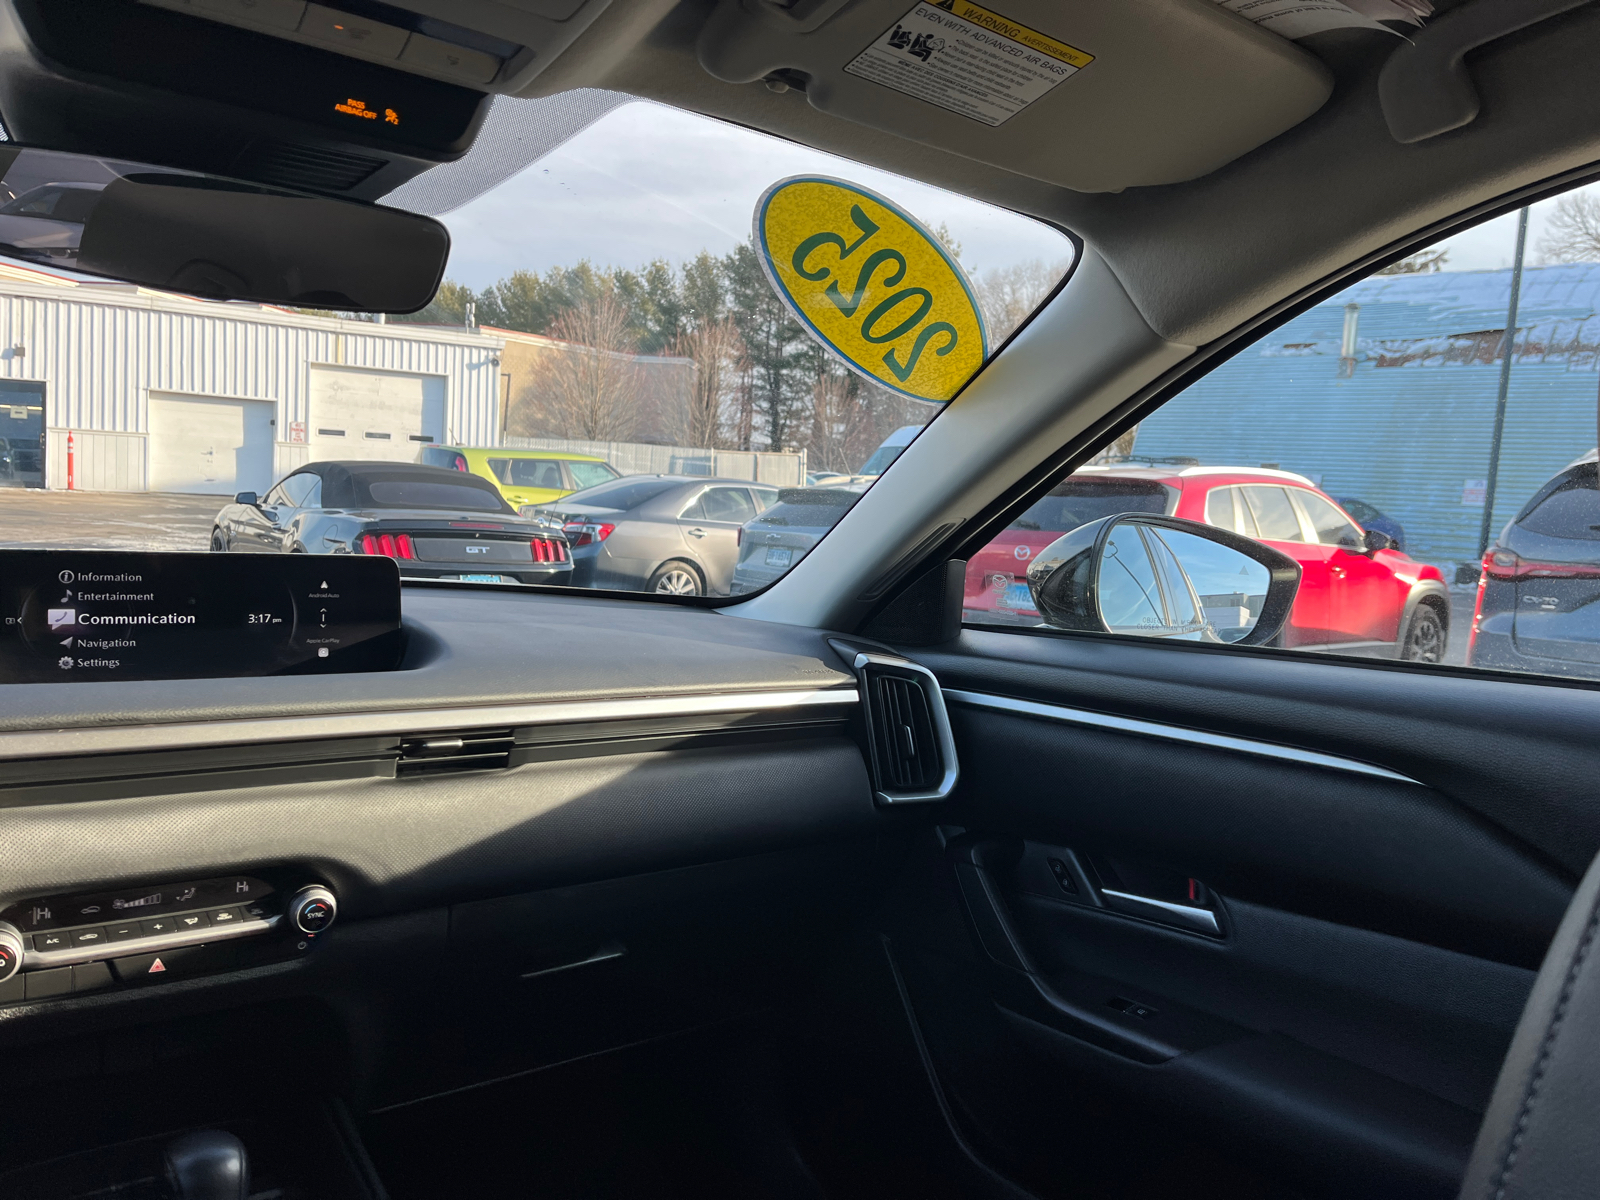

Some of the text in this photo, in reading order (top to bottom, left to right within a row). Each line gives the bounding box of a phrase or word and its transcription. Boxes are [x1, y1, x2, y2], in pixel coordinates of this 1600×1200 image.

[963, 8, 1078, 61] WARNING AVERTISSEMENT
[915, 8, 1067, 75] EVEN WITH ADVANCED AIR BAGS
[348, 98, 365, 109] PASS
[335, 104, 377, 119] AIRBAG OFF
[466, 546, 490, 554] GT
[78, 573, 142, 582] Information
[78, 592, 154, 601] Entertainment
[78, 613, 196, 625] Communication
[248, 614, 271, 623] 3:17
[78, 639, 136, 650] Navigation
[78, 658, 120, 668] Settings
[307, 911, 324, 919] SYNC
